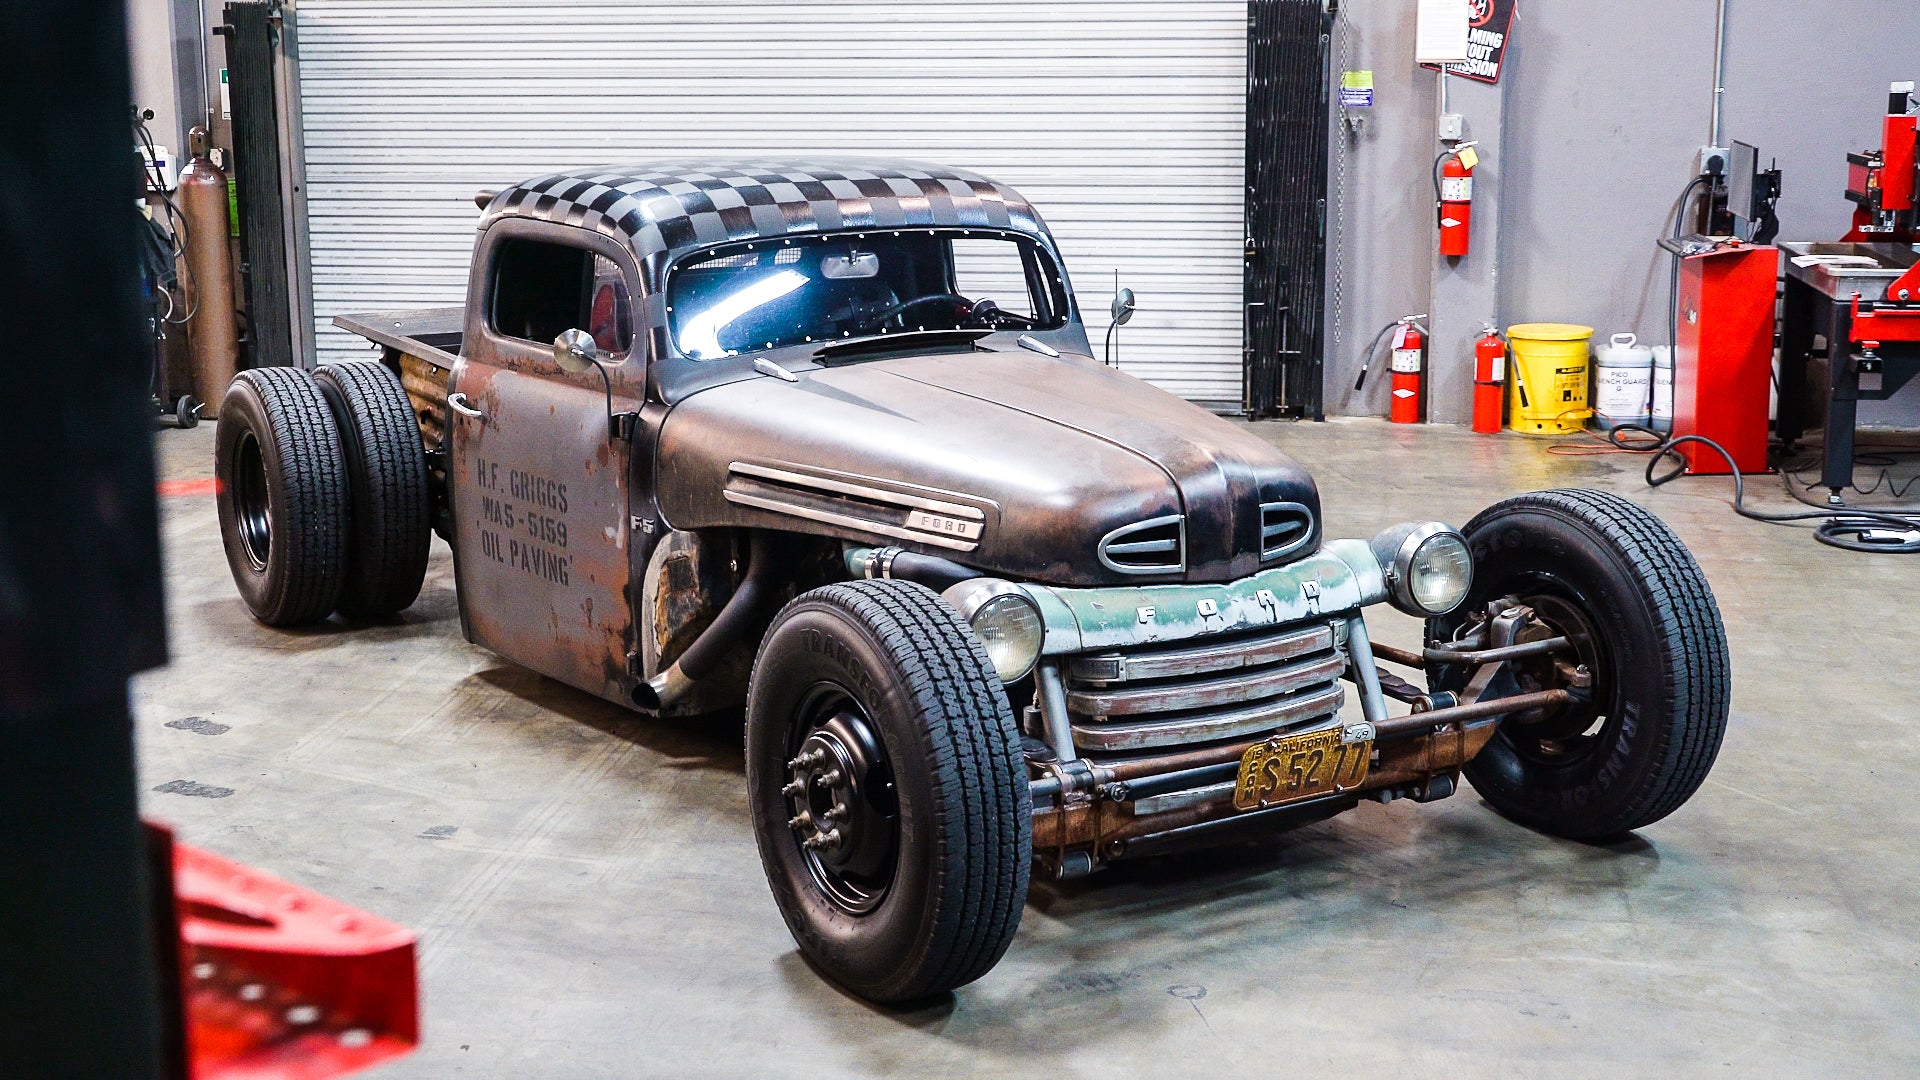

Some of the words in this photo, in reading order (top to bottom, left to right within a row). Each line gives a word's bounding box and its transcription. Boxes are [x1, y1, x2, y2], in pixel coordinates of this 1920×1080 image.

[1468, 28, 1503, 48] MING
[1467, 43, 1494, 60] OUT
[510, 469, 568, 514] GRIGGS
[921, 517, 966, 533] FORD
[1136, 580, 1321, 624] FORD
[1273, 730, 1342, 755] CALIFORNIA
